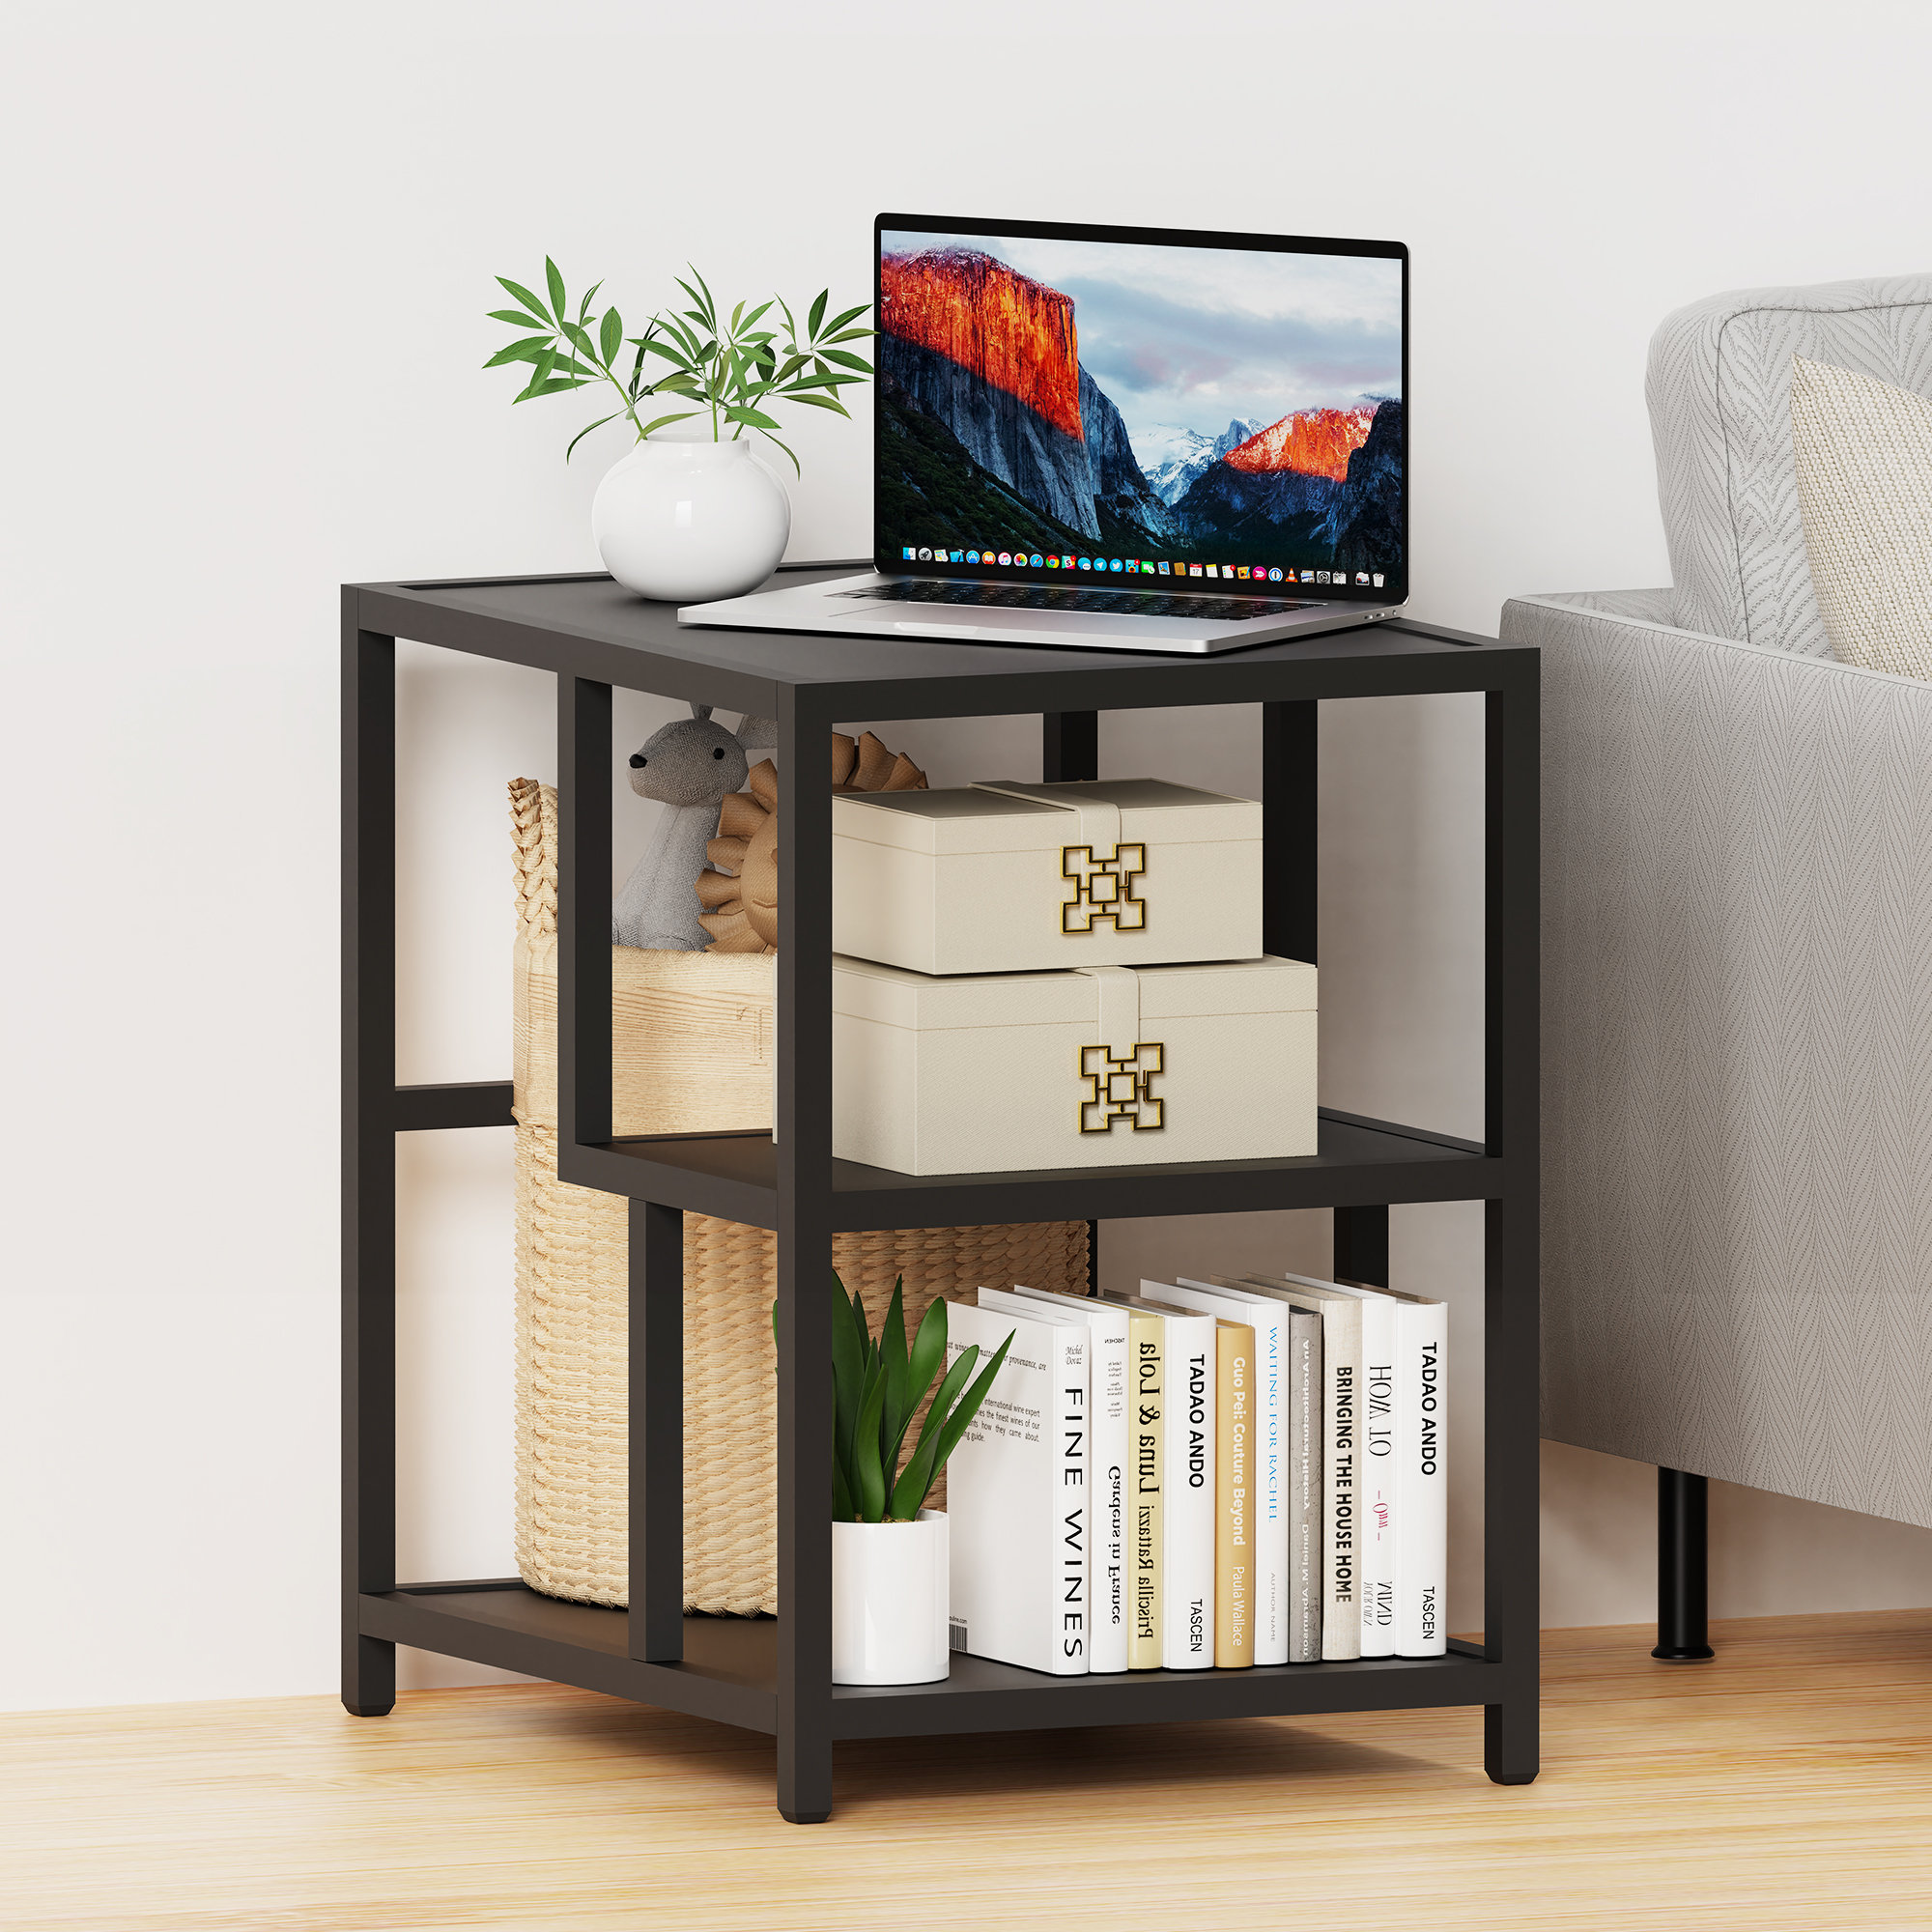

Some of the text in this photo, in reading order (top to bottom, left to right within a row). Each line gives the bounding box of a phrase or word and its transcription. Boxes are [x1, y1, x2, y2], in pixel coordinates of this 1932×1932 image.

[981, 1420, 992, 1432] how
[995, 1424, 1007, 1437] they
[1009, 1429, 1022, 1438] came
[995, 1412, 1009, 1424] finest
[1009, 1416, 1024, 1428] wines
[1031, 1422, 1040, 1431] our
[1013, 1404, 1024, 1414] wine
[1025, 1405, 1040, 1418] expert
[1188, 1353, 1206, 1489] TADAO ANDO
[1230, 1356, 1247, 1547] Guo Pei: Couture Beyond
[1268, 1326, 1278, 1523] WAITING FOR RACHEL
[1421, 1341, 1437, 1476] TADAO ANDO
[1064, 1388, 1083, 1658] FINE WINES
[1335, 1366, 1353, 1604] BRINGING THE HOUSE HOME
[1189, 1599, 1203, 1653] TASCEN
[1232, 1566, 1246, 1647] Paula Wallace
[1422, 1585, 1435, 1640] TASCEN
